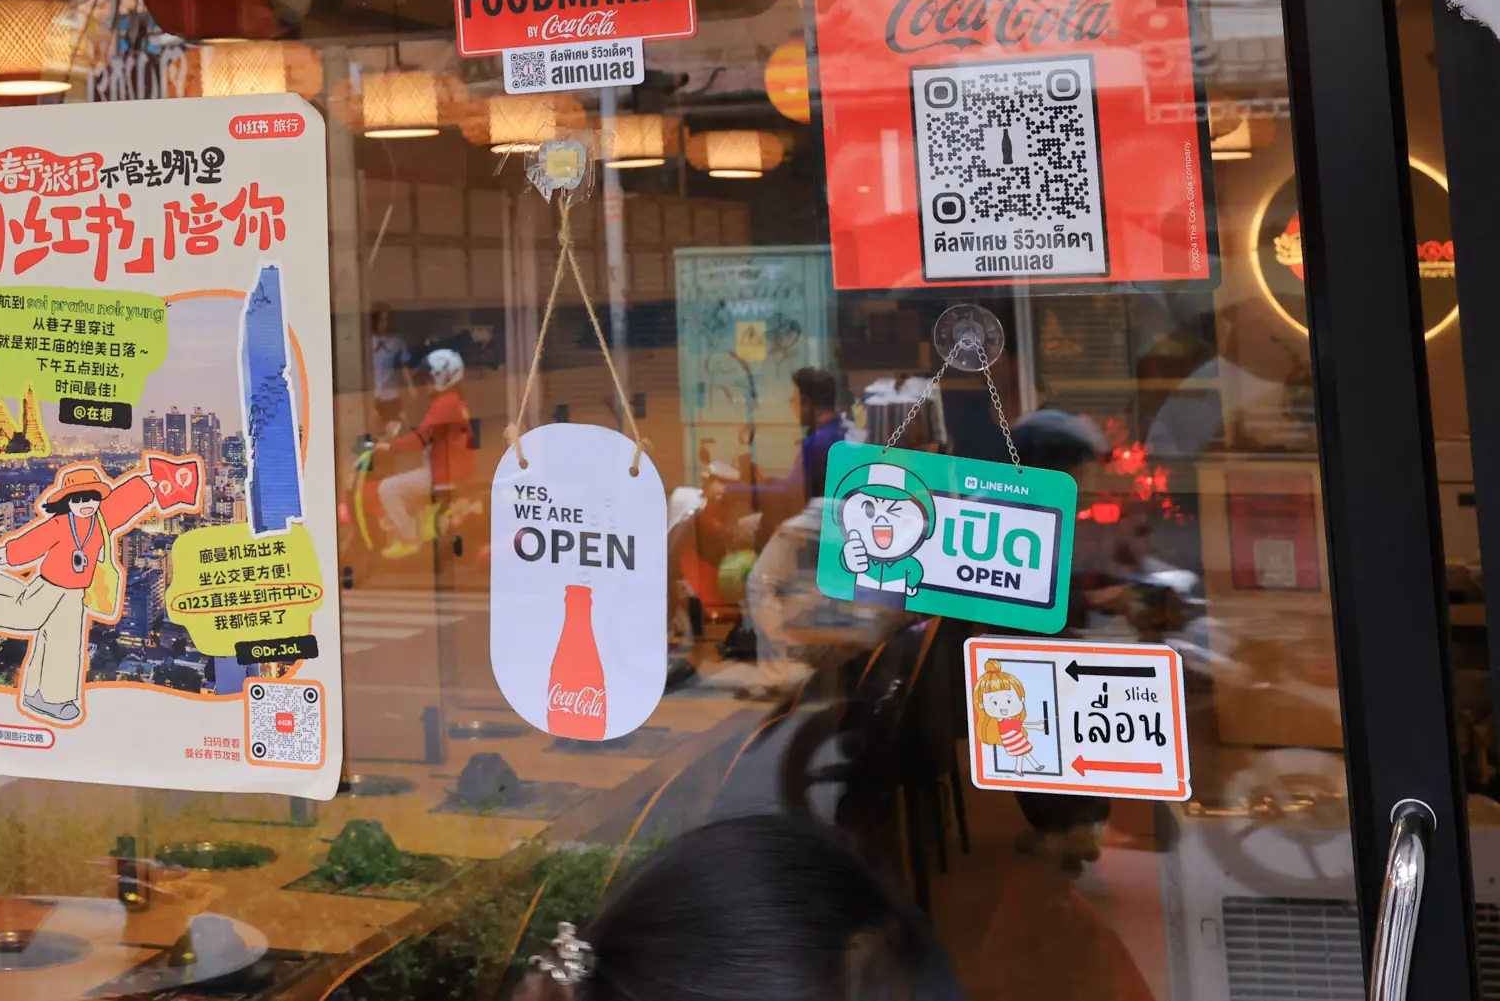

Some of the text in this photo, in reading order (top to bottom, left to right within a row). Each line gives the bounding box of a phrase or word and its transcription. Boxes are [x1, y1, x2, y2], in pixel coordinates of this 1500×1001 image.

[527, 9, 618, 41] BY Coca-Cola
[550, 44, 633, 63] ดีลพิเศษ รีวิวเด็ดๆ
[551, 60, 635, 86] สแกนเลย
[234, 118, 299, 135] 小红书 旅行
[933, 223, 1094, 253] ดีลพิเศษ รีวิวเด็ดๆ
[975, 253, 1054, 273] สแกนเลย
[27, 295, 48, 309] soi
[51, 299, 95, 315] pratu
[33, 317, 116, 337] 从巷子里穿过
[73, 406, 113, 422] @在想
[514, 484, 553, 504] YES,
[514, 504, 584, 524] WE ARE
[513, 526, 636, 571] OPEN
[941, 508, 1042, 570] เปิด
[199, 541, 286, 564] 廊曼机场出来
[956, 564, 1021, 591] OPEN
[214, 609, 285, 631] 我都惊呆了
[548, 682, 605, 718] Coca-Cola
[1125, 688, 1159, 704] slide
[1073, 681, 1167, 748] เลื่อน
